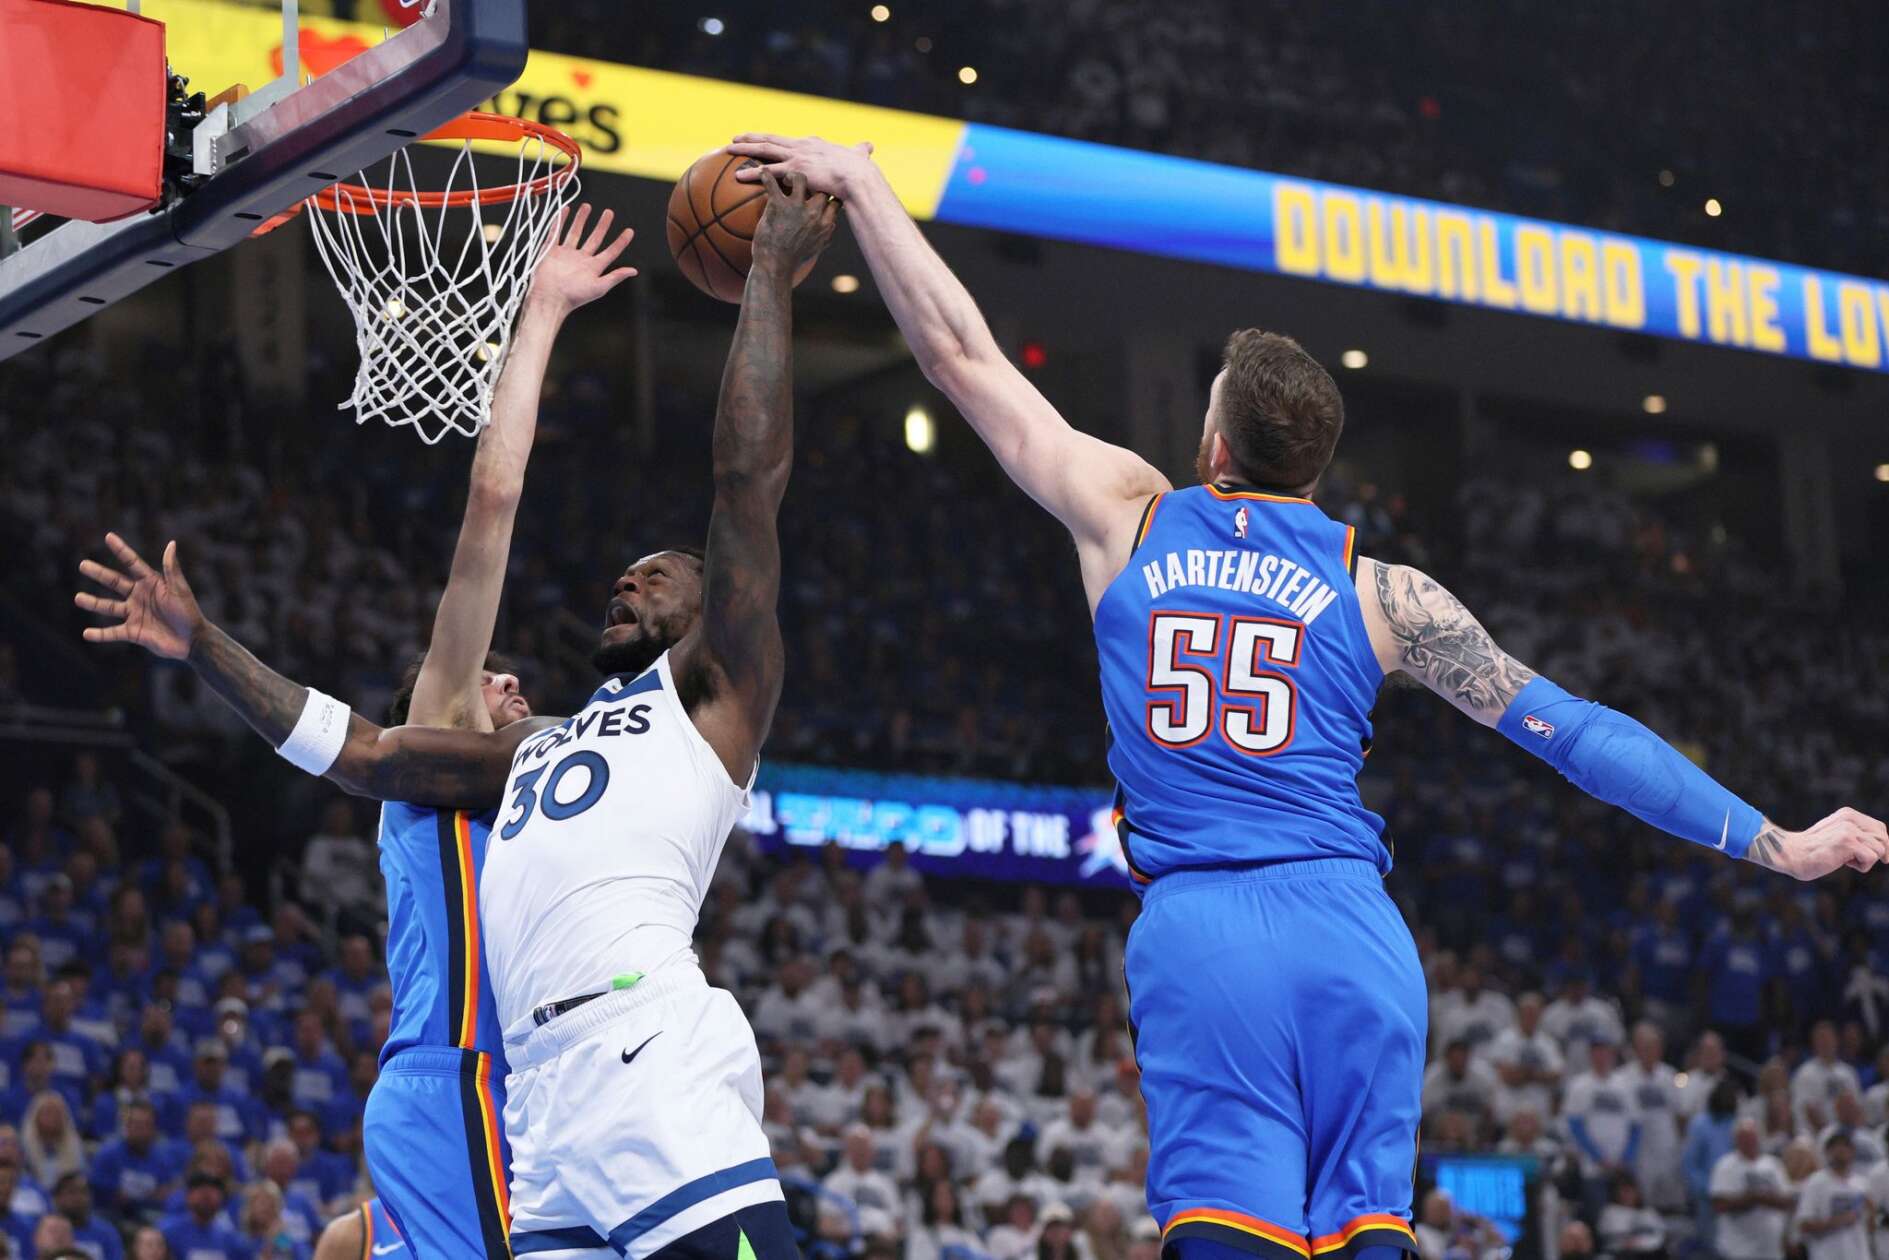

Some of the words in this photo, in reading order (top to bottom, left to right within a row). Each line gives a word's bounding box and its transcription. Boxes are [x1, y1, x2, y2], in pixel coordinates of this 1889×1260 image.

[474, 92, 621, 154] ves
[1273, 181, 1646, 329] DOWNLOAD
[1665, 250, 1787, 353] THE
[1803, 272, 1889, 368] LO
[1142, 549, 1338, 626] HARTENSTEIN
[1146, 609, 1305, 757] 55
[512, 704, 652, 770] WOLVES
[500, 750, 610, 840] 30
[1011, 811, 1071, 857] THE
